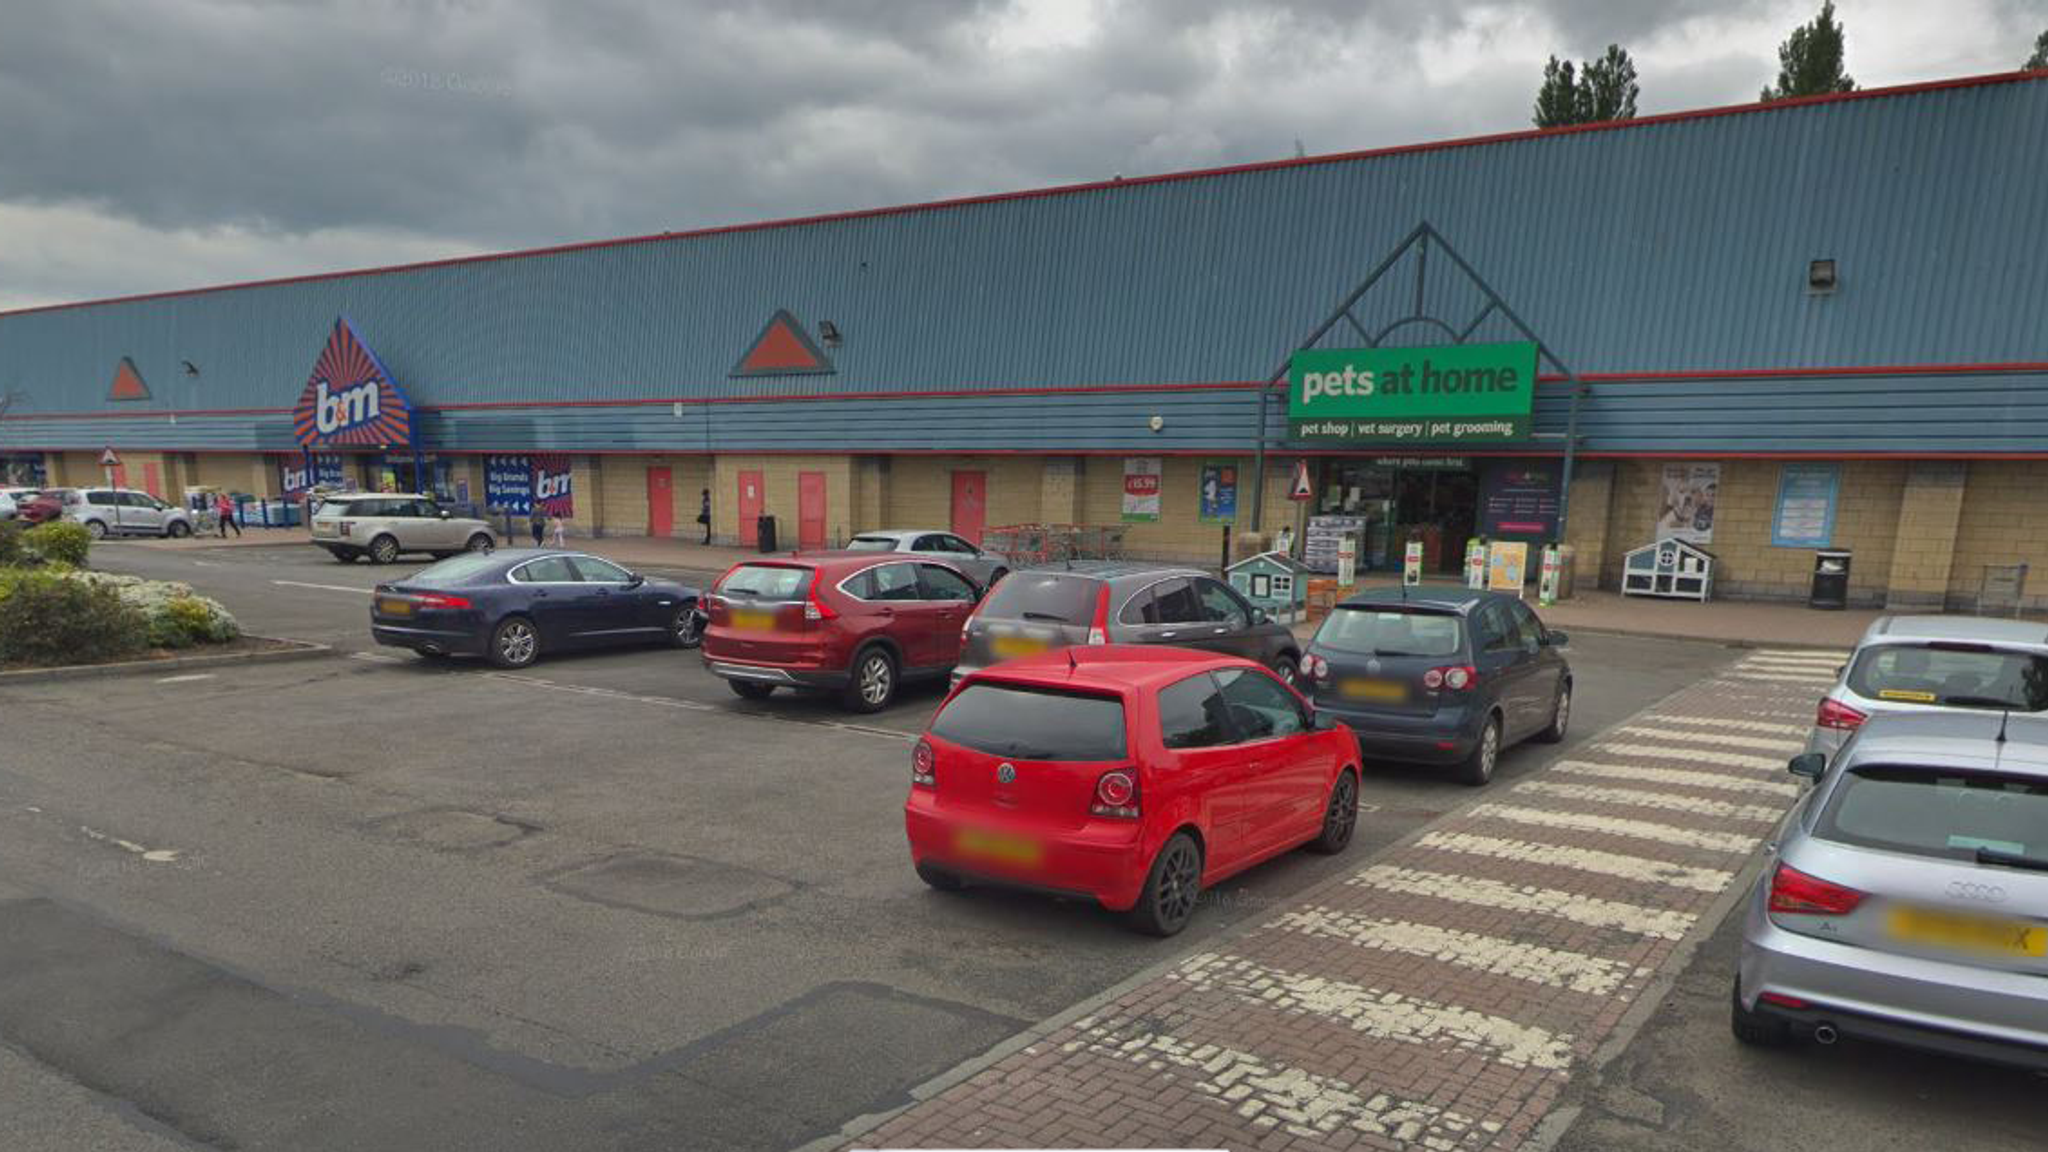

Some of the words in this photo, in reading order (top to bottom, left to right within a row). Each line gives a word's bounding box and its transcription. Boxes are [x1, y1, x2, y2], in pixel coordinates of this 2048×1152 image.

[1303, 365, 1374, 405] pets
[1381, 363, 1415, 395] at
[1422, 359, 1517, 394] home
[317, 381, 380, 433] b&m
[1302, 424, 1318, 437] pet
[1321, 422, 1349, 437] shop
[1358, 424, 1376, 434] vet
[1378, 424, 1422, 438] surgery
[1432, 422, 1450, 437] pet
[1453, 421, 1514, 438] grooming
